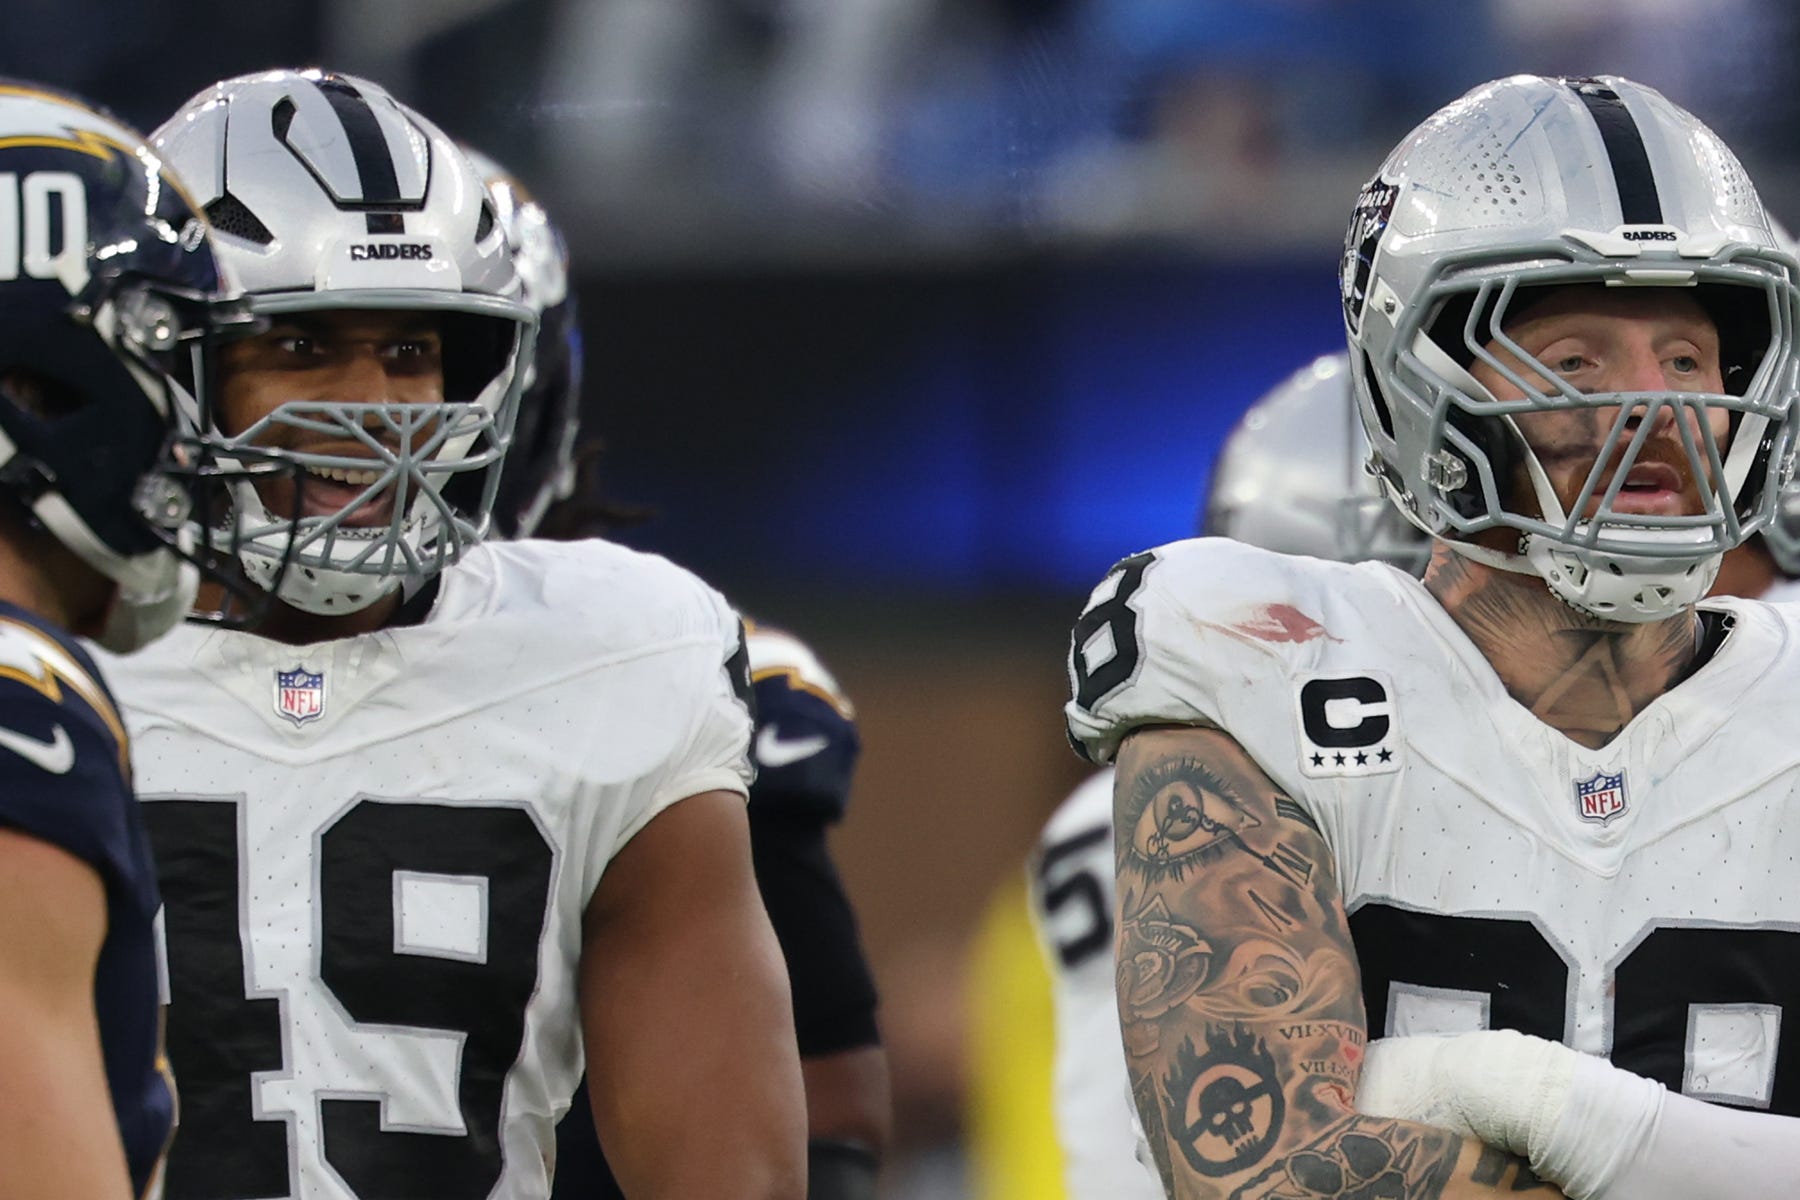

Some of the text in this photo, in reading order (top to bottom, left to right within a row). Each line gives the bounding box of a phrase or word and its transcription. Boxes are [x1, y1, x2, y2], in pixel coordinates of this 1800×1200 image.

[1622, 231, 1677, 241] RAIDERS
[350, 244, 433, 260] RAIDERS
[283, 689, 318, 715] NFL
[1300, 677, 1390, 748] C
[1583, 790, 1621, 815] NFL
